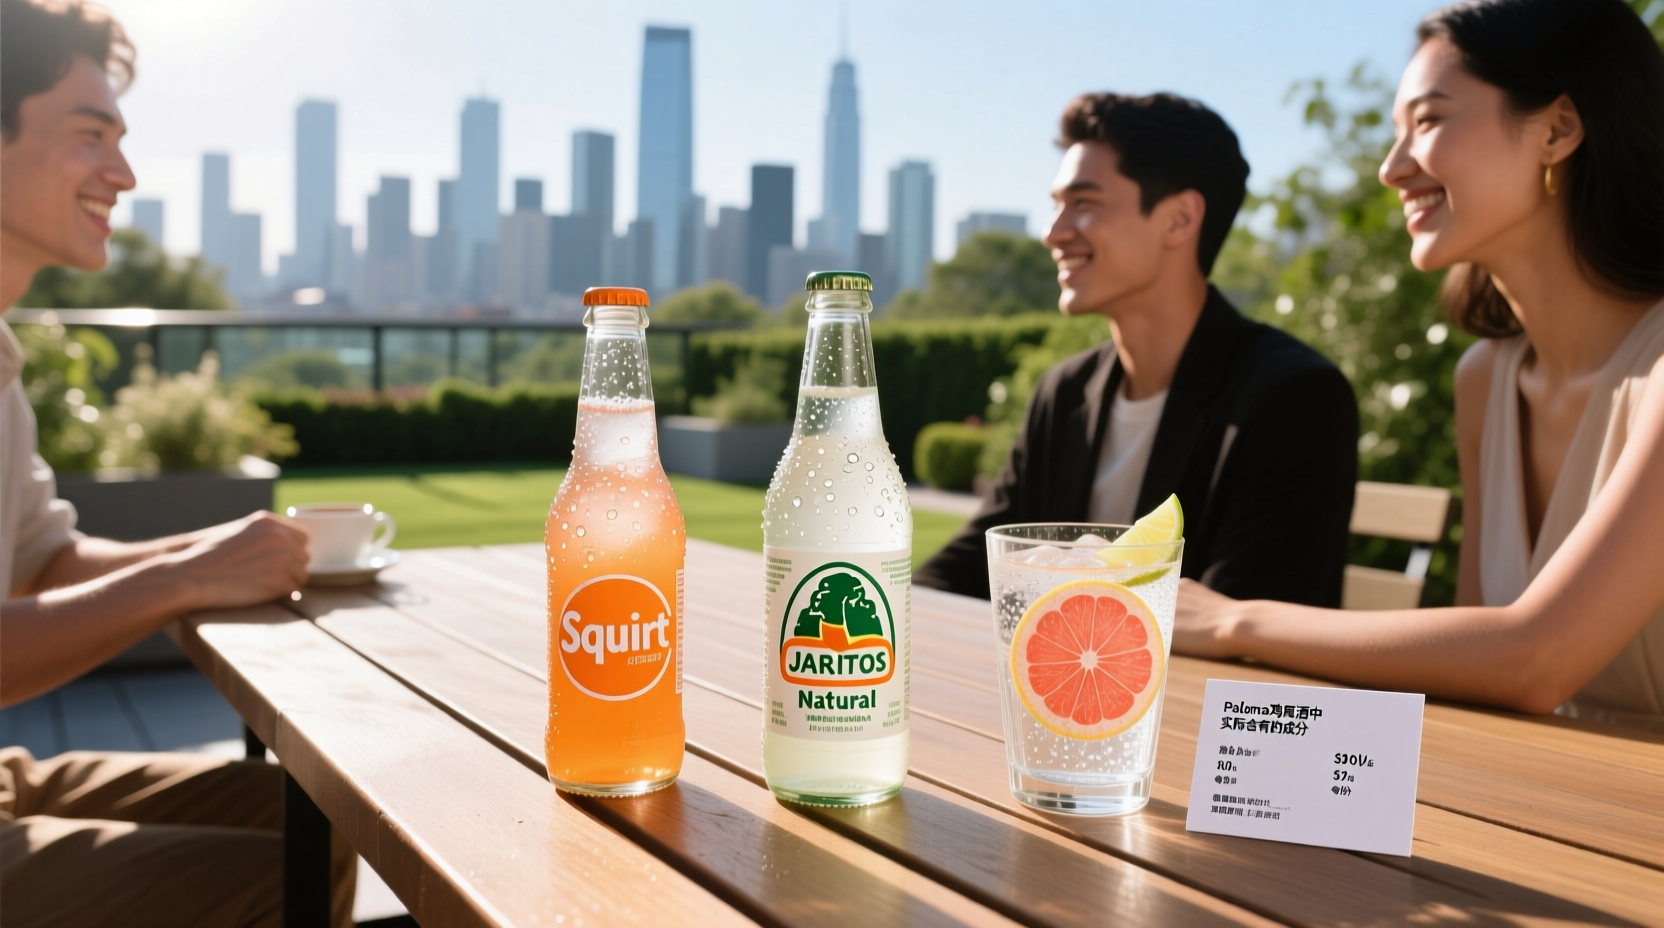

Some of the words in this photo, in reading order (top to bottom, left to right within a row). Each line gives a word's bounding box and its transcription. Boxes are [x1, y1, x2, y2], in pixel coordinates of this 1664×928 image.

[561, 610, 669, 665] Squirt
[789, 651, 886, 675] JARITOS
[798, 689, 876, 710] Natural
